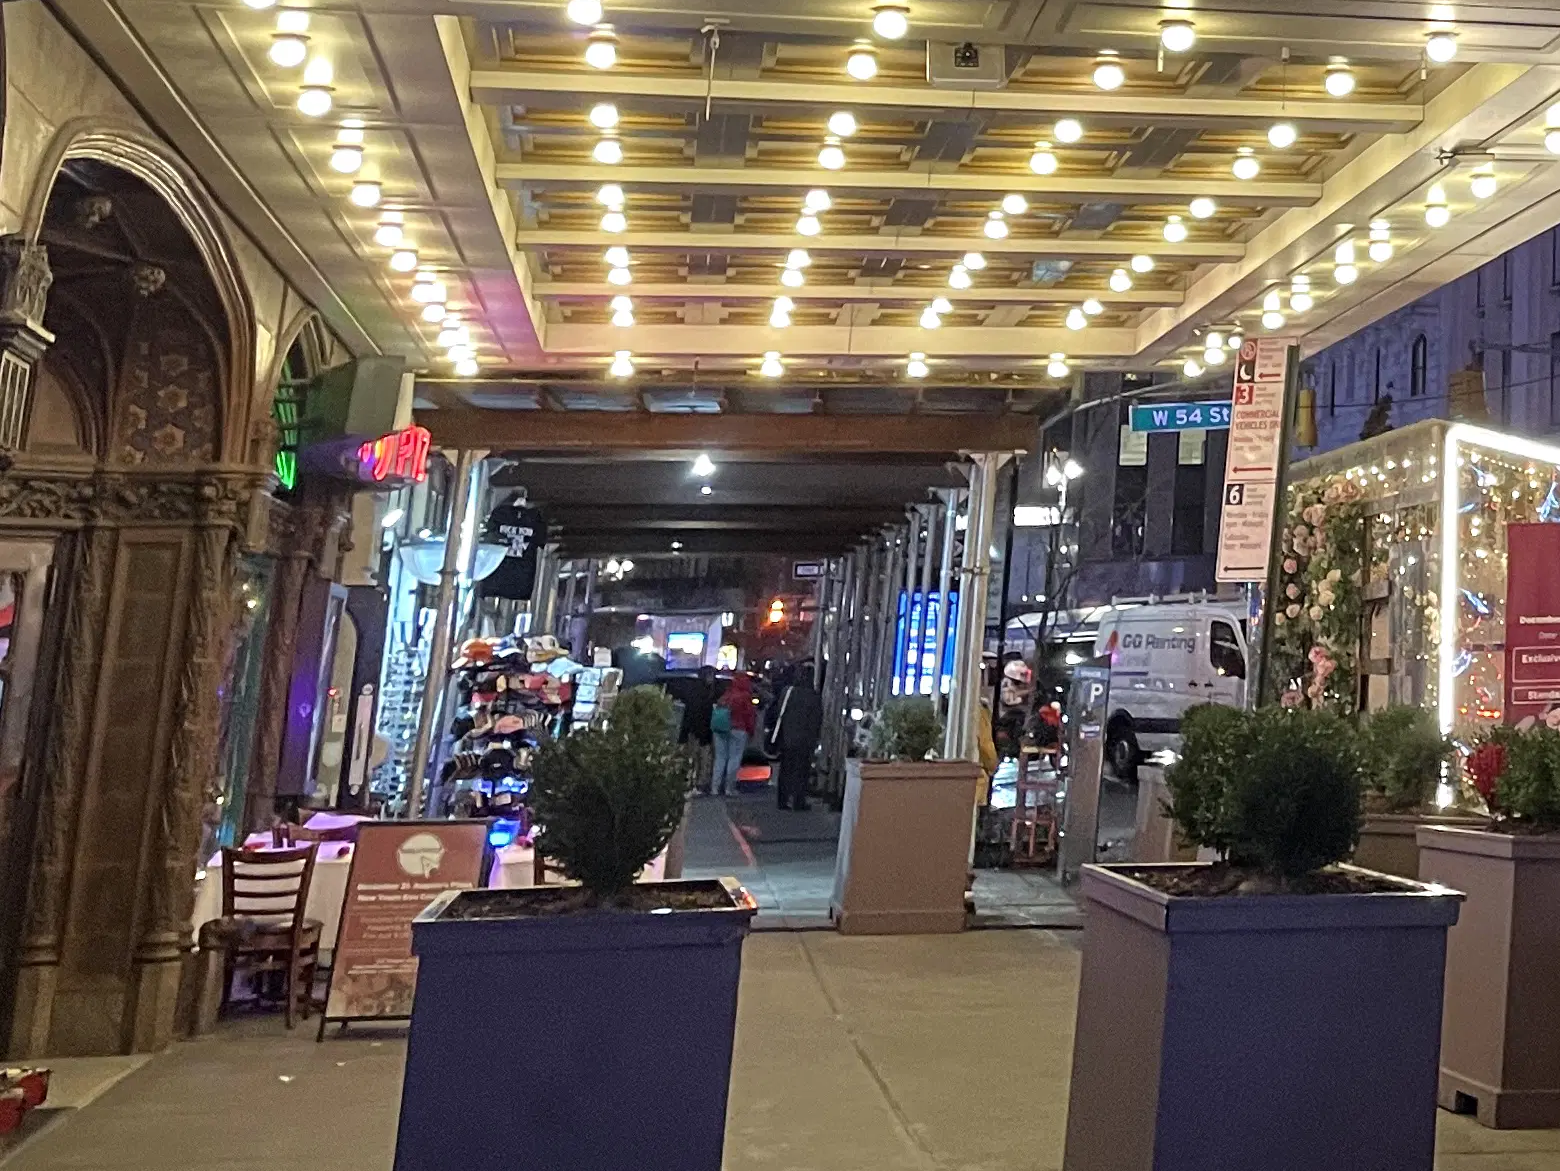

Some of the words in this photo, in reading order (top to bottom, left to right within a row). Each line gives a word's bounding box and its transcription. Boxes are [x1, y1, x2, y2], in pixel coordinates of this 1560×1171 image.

[1239, 385, 1250, 404] 3
[1152, 410, 1168, 426] W
[1176, 408, 1203, 425] 54
[1209, 407, 1230, 423] St
[1236, 410, 1279, 420] COMMERCIAL
[1235, 420, 1268, 430] VEHICLES
[1229, 485, 1240, 505] 6
[1090, 683, 1104, 703] P
